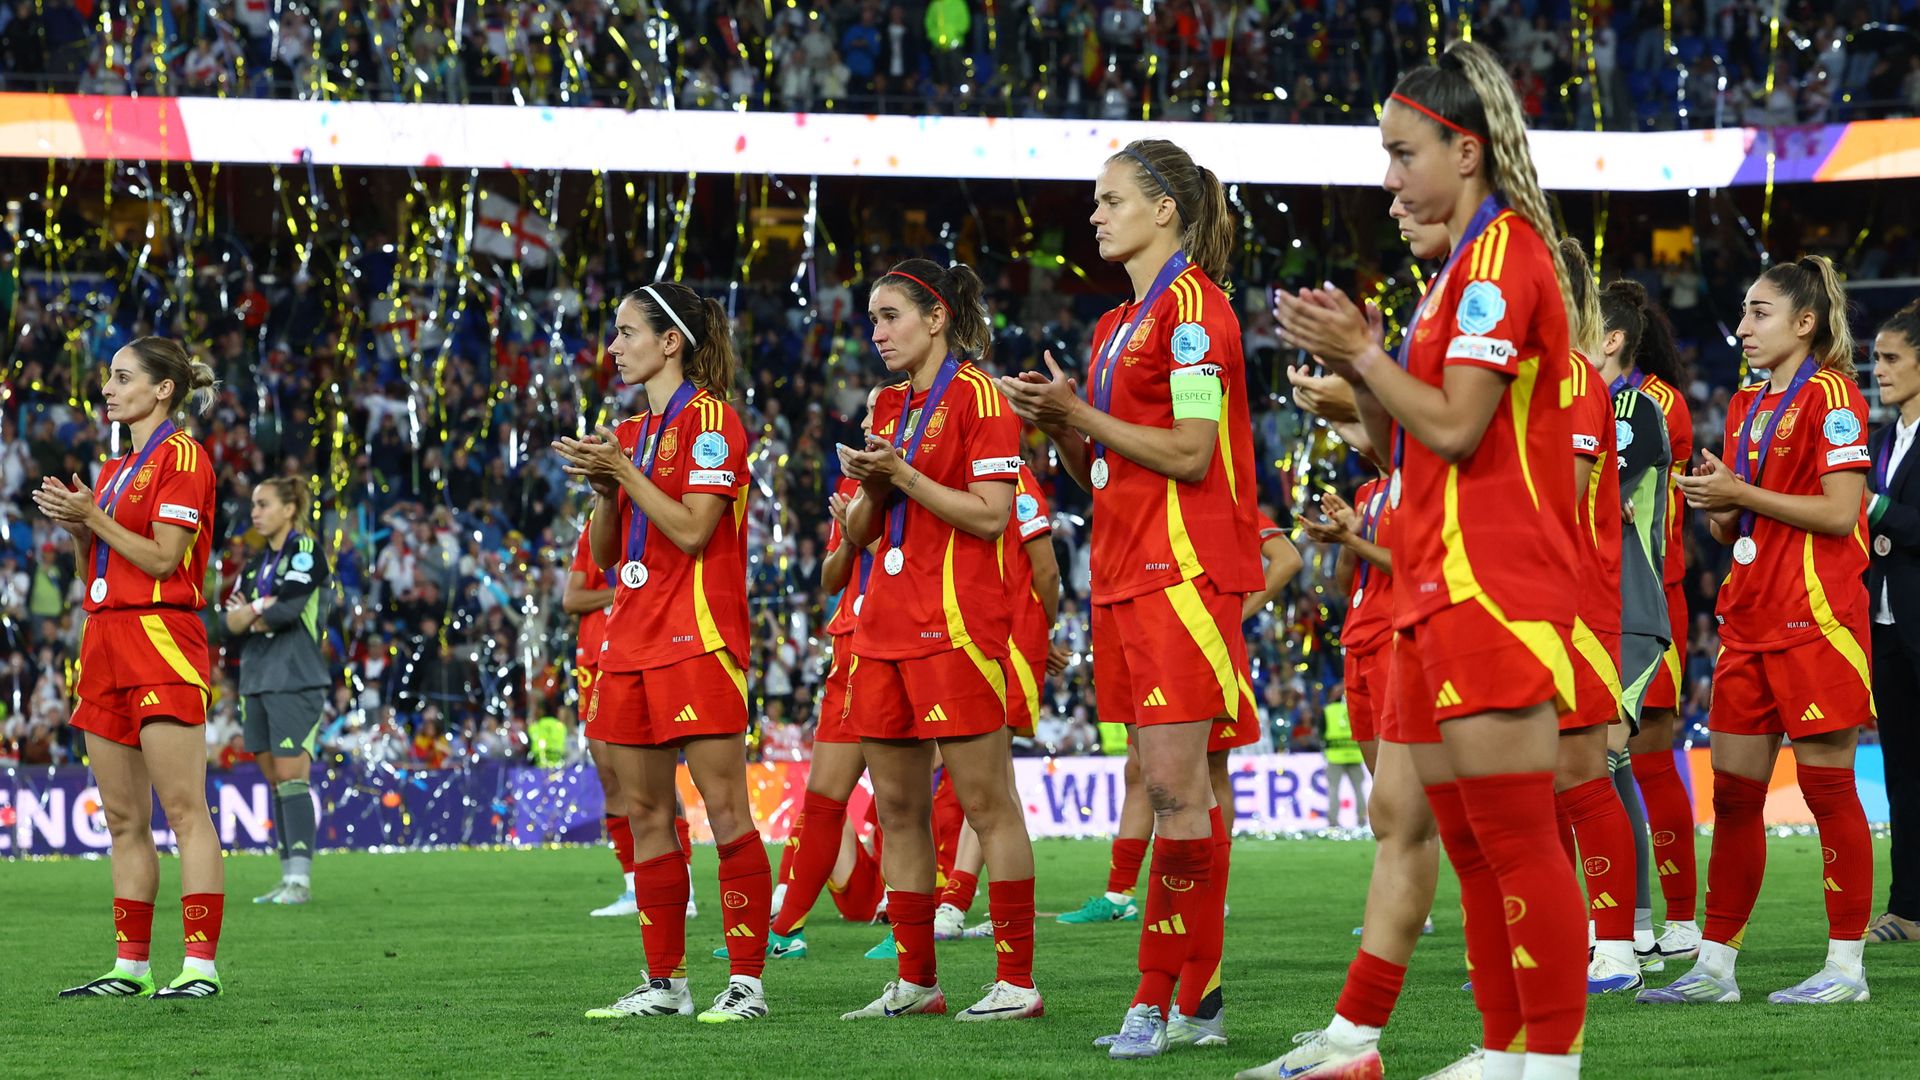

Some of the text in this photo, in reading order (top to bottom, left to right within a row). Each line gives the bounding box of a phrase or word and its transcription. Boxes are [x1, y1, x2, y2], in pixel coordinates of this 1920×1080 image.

[1490, 345, 1507, 357] 10
[1201, 367, 1215, 376] 10
[1175, 392, 1212, 401] RESPECT
[1006, 460, 1018, 468] 10
[1042, 766, 1328, 823] WIERS
